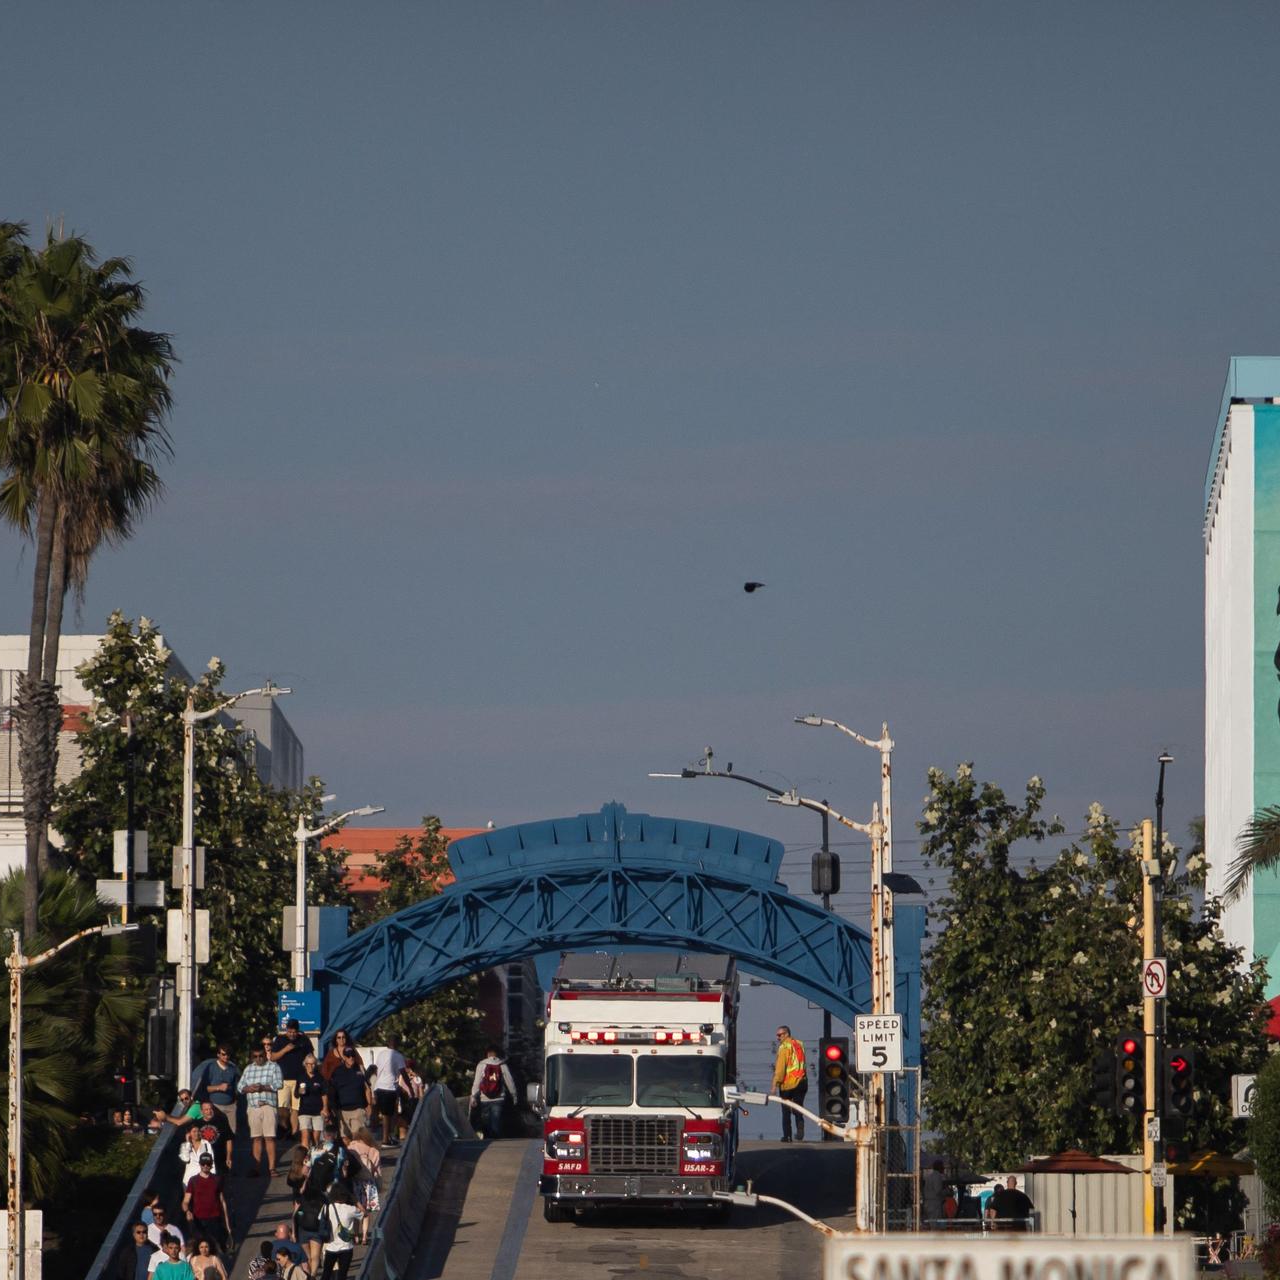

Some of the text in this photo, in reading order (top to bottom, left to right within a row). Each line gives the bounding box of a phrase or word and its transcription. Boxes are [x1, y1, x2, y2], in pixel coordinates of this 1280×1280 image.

[859, 1019, 899, 1029] SPEED
[862, 1033, 895, 1042] LIMIT
[871, 1046, 888, 1067] 5
[683, 1164, 715, 1172] USAR-2
